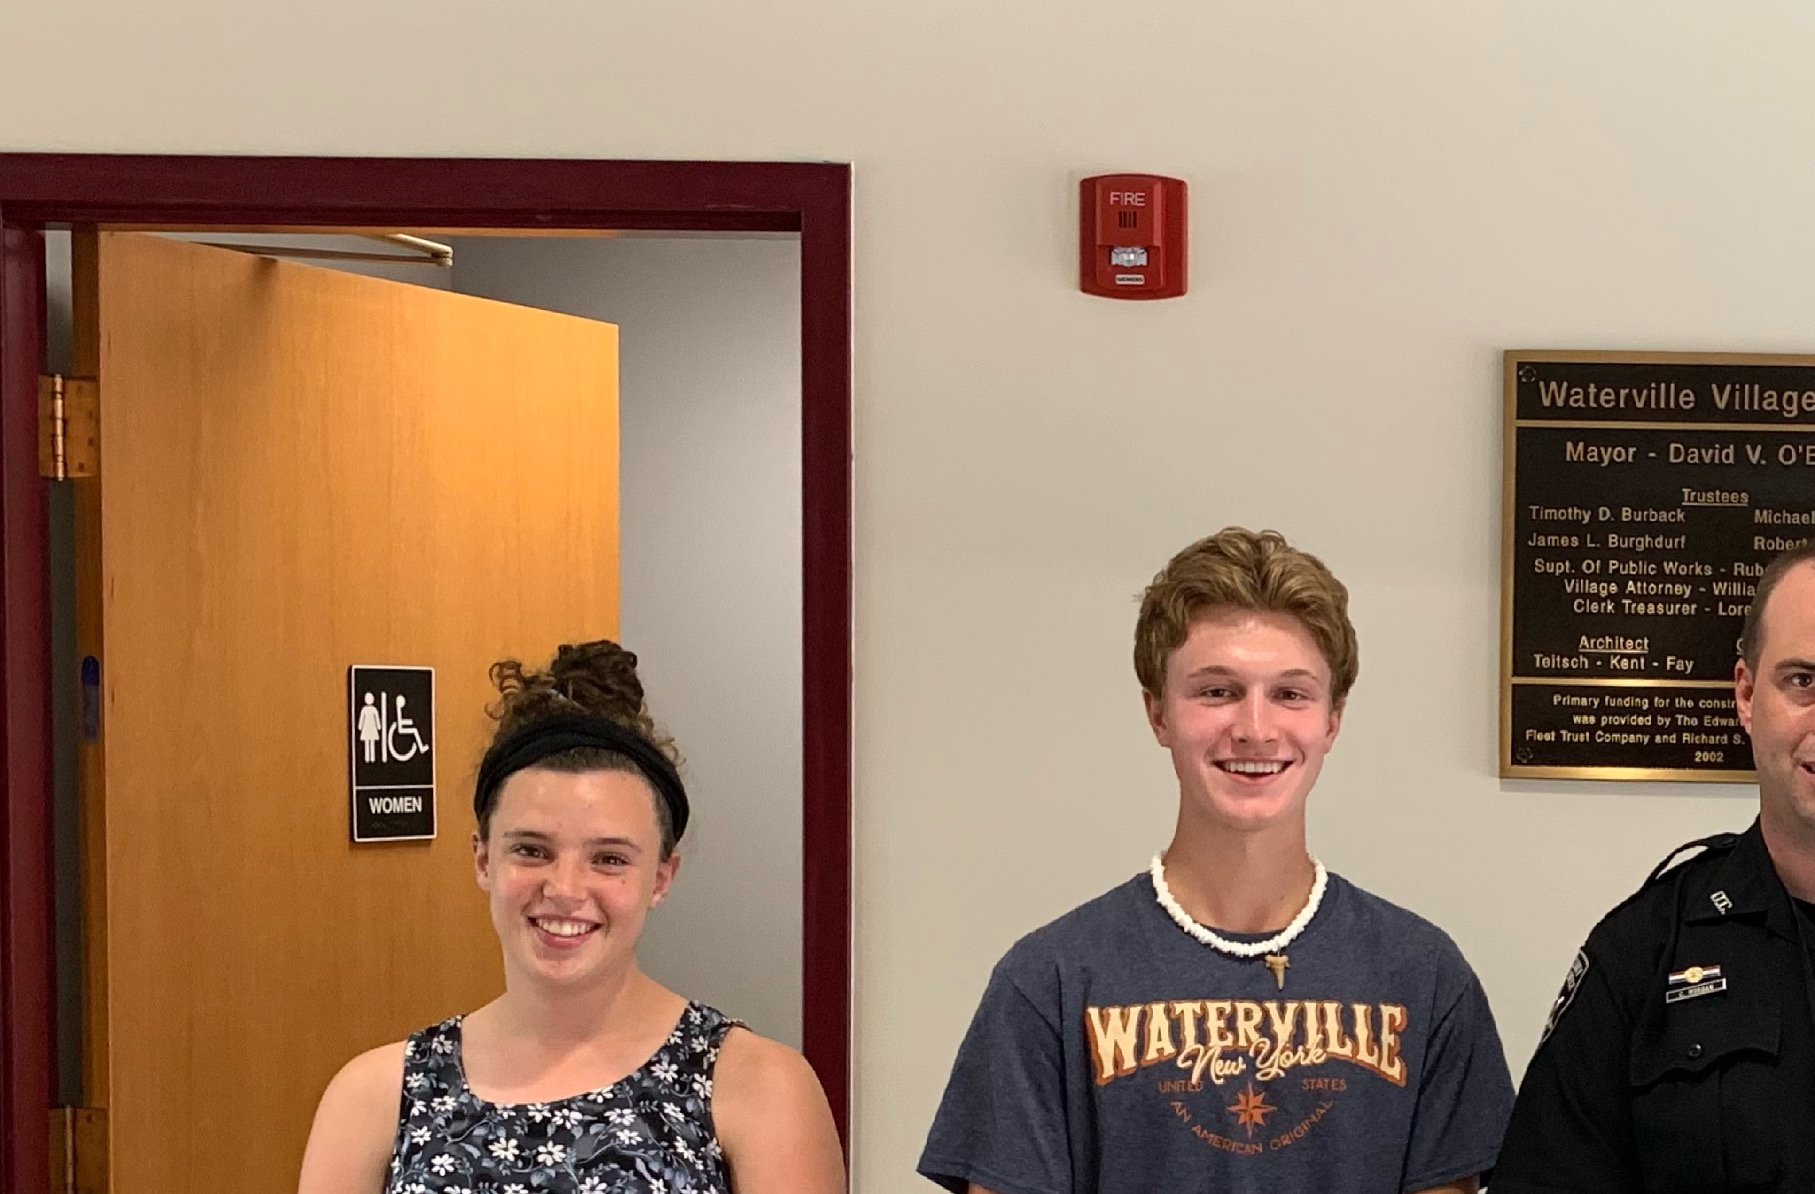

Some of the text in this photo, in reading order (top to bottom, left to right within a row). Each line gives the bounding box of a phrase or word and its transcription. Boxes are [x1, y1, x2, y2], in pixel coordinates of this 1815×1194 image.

[1109, 191, 1146, 207] FIRE
[1538, 379, 1697, 412] Waterville
[1565, 440, 1637, 468] Mayor
[1668, 442, 1736, 466] David
[1744, 443, 1767, 466] V.
[1681, 487, 1750, 504] Trustees
[1528, 505, 1686, 524] Timothy D. Burback
[1753, 508, 1815, 525] Michael
[1527, 533, 1687, 552] James L. Burghdurf
[1534, 557, 1576, 577] Supt.
[1581, 559, 1602, 575] Of
[1608, 559, 1658, 576] Public
[1662, 560, 1713, 577] Works
[1733, 561, 1769, 577] Rub
[1564, 578, 1619, 597] Village
[1625, 580, 1692, 599] Attorney
[1573, 598, 1616, 614] Clerk
[1621, 599, 1698, 617] Treasurer
[1578, 634, 1650, 651] Architect
[1609, 654, 1646, 670] Kent
[1666, 655, 1695, 674] Fay
[1552, 693, 1600, 709] Primary
[1604, 694, 1650, 710] funding
[1653, 695, 1671, 708] for
[1674, 696, 1694, 709] the
[1572, 714, 1597, 725] was
[1600, 713, 1652, 728] provided
[1656, 714, 1672, 729] by
[1675, 714, 1699, 727] The
[1525, 728, 1746, 746] Fleet Trust Company and Richard S.
[1693, 750, 1725, 763] 2002
[368, 795, 423, 814] WOMEN
[1084, 999, 1408, 1088] WATERVILLE
[1175, 1033, 1328, 1086] New York
[1157, 1077, 1348, 1094] UNITED STATES
[1170, 1098, 1336, 1154] AN AMERICAN ORIGINAL
